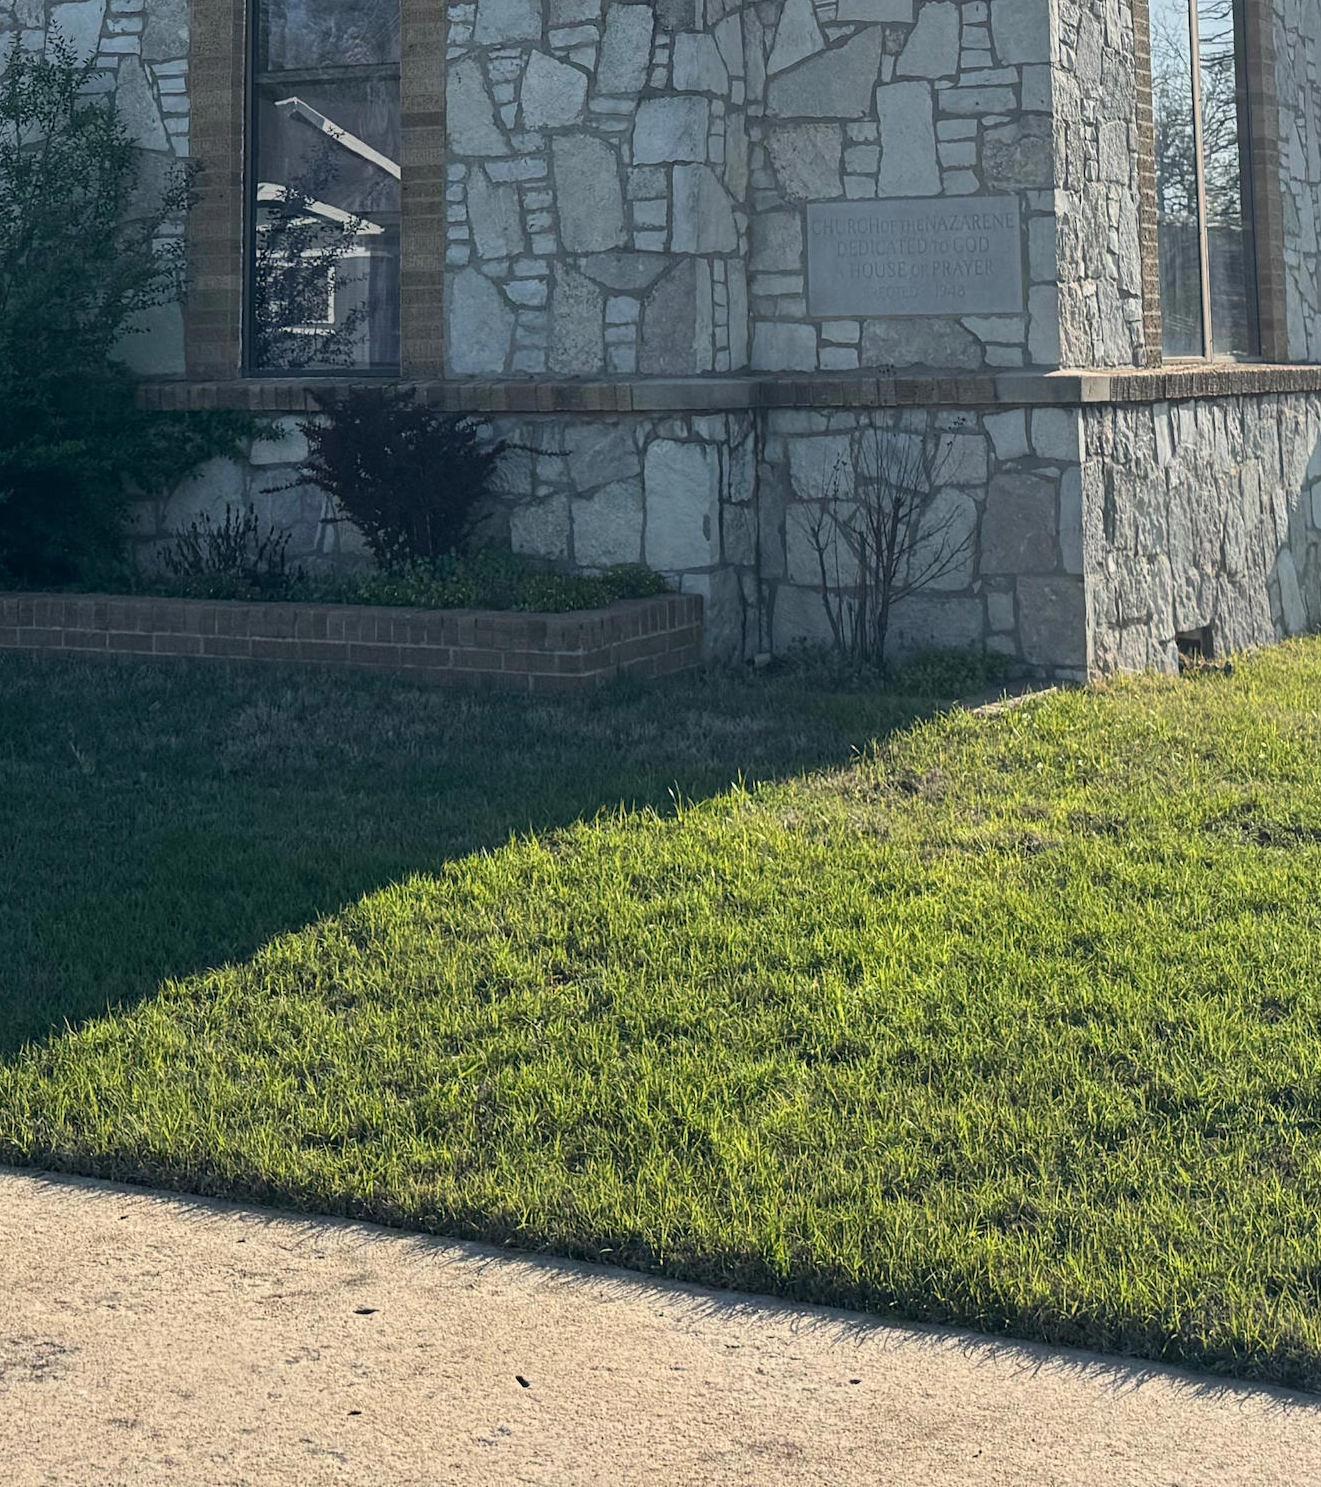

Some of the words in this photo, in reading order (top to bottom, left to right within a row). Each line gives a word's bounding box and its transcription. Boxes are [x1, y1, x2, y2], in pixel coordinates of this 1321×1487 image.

[812, 217, 879, 235] CHURCH
[926, 213, 1015, 232] NAZARENE
[837, 238, 928, 257] DEDICATED
[953, 236, 990, 254] GOD
[849, 261, 907, 279] HOUSE
[932, 259, 994, 277] PRAYER
